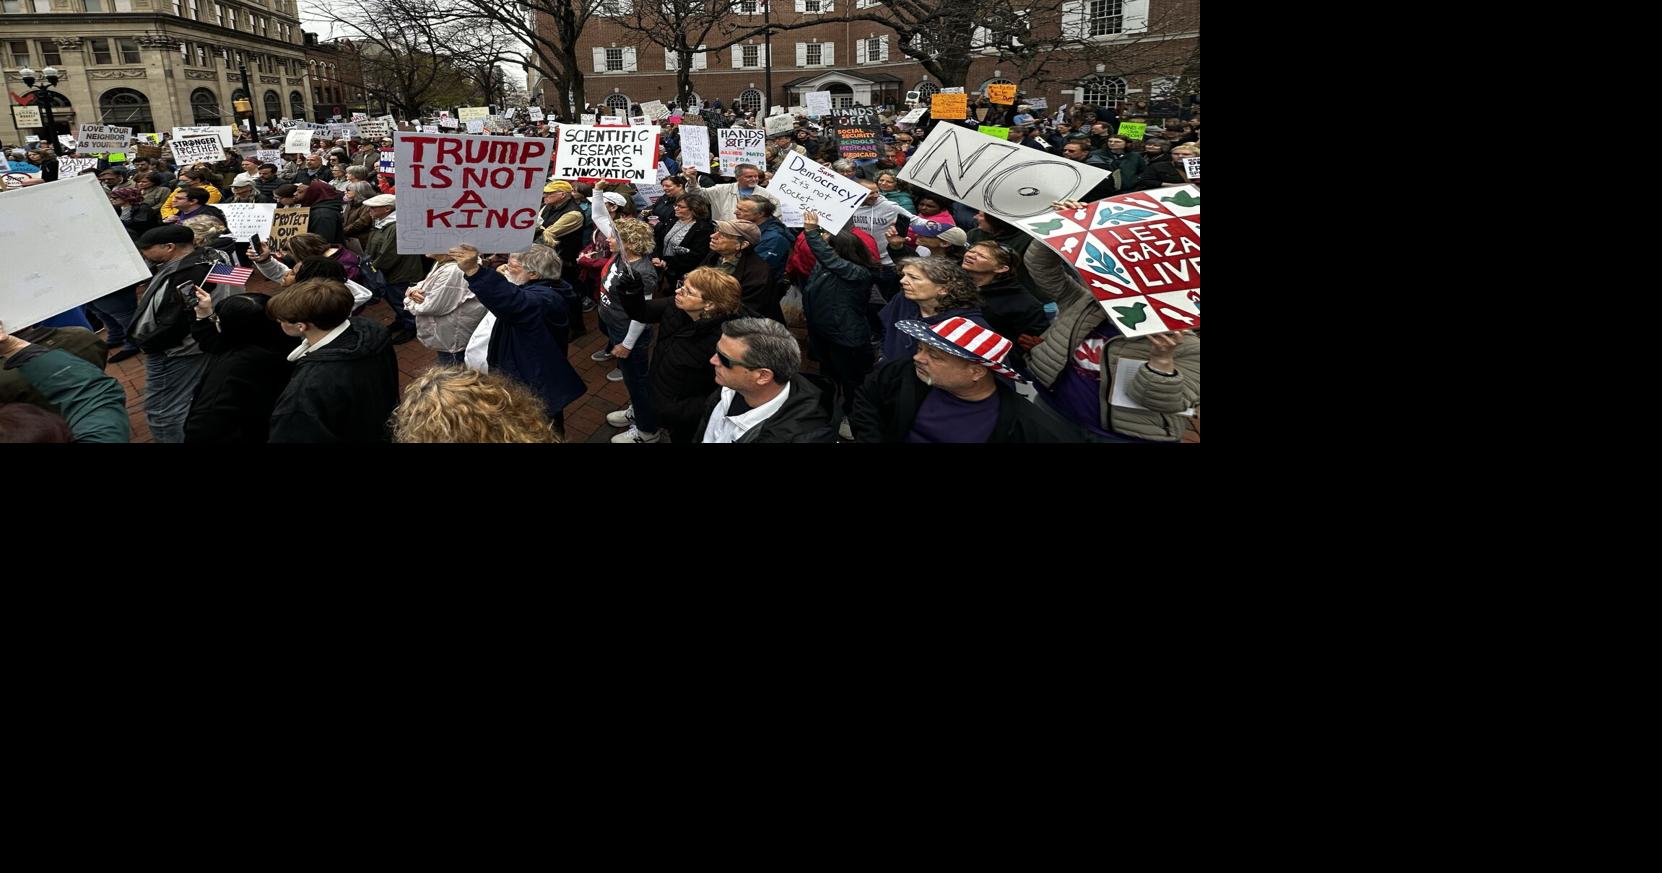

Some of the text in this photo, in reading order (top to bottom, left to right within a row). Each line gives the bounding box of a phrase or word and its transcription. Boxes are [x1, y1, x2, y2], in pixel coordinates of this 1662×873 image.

[832, 107, 874, 117] HANDS
[839, 116, 871, 126] OFF!
[172, 137, 217, 148] STRONGER
[564, 129, 649, 143] SCIENTIFIC
[721, 130, 764, 139] HANDS
[175, 143, 219, 156] TOGETHER
[400, 136, 546, 165] TRUMP
[571, 144, 643, 156] RESEARCH
[60, 158, 96, 166] HANDS
[578, 156, 633, 168] DRIVES
[409, 164, 544, 189] IS NOT
[562, 167, 645, 180] INNOVATION
[909, 127, 1082, 217] NO
[788, 155, 868, 209] Democracy!
[792, 176, 833, 201] It's not
[451, 190, 488, 209] A
[779, 183, 813, 204] Rocket
[273, 212, 309, 226] PROTECT
[426, 207, 537, 229] KING
[800, 203, 833, 222] Science
[1108, 223, 1172, 244] LET
[1116, 236, 1200, 262] GAZA
